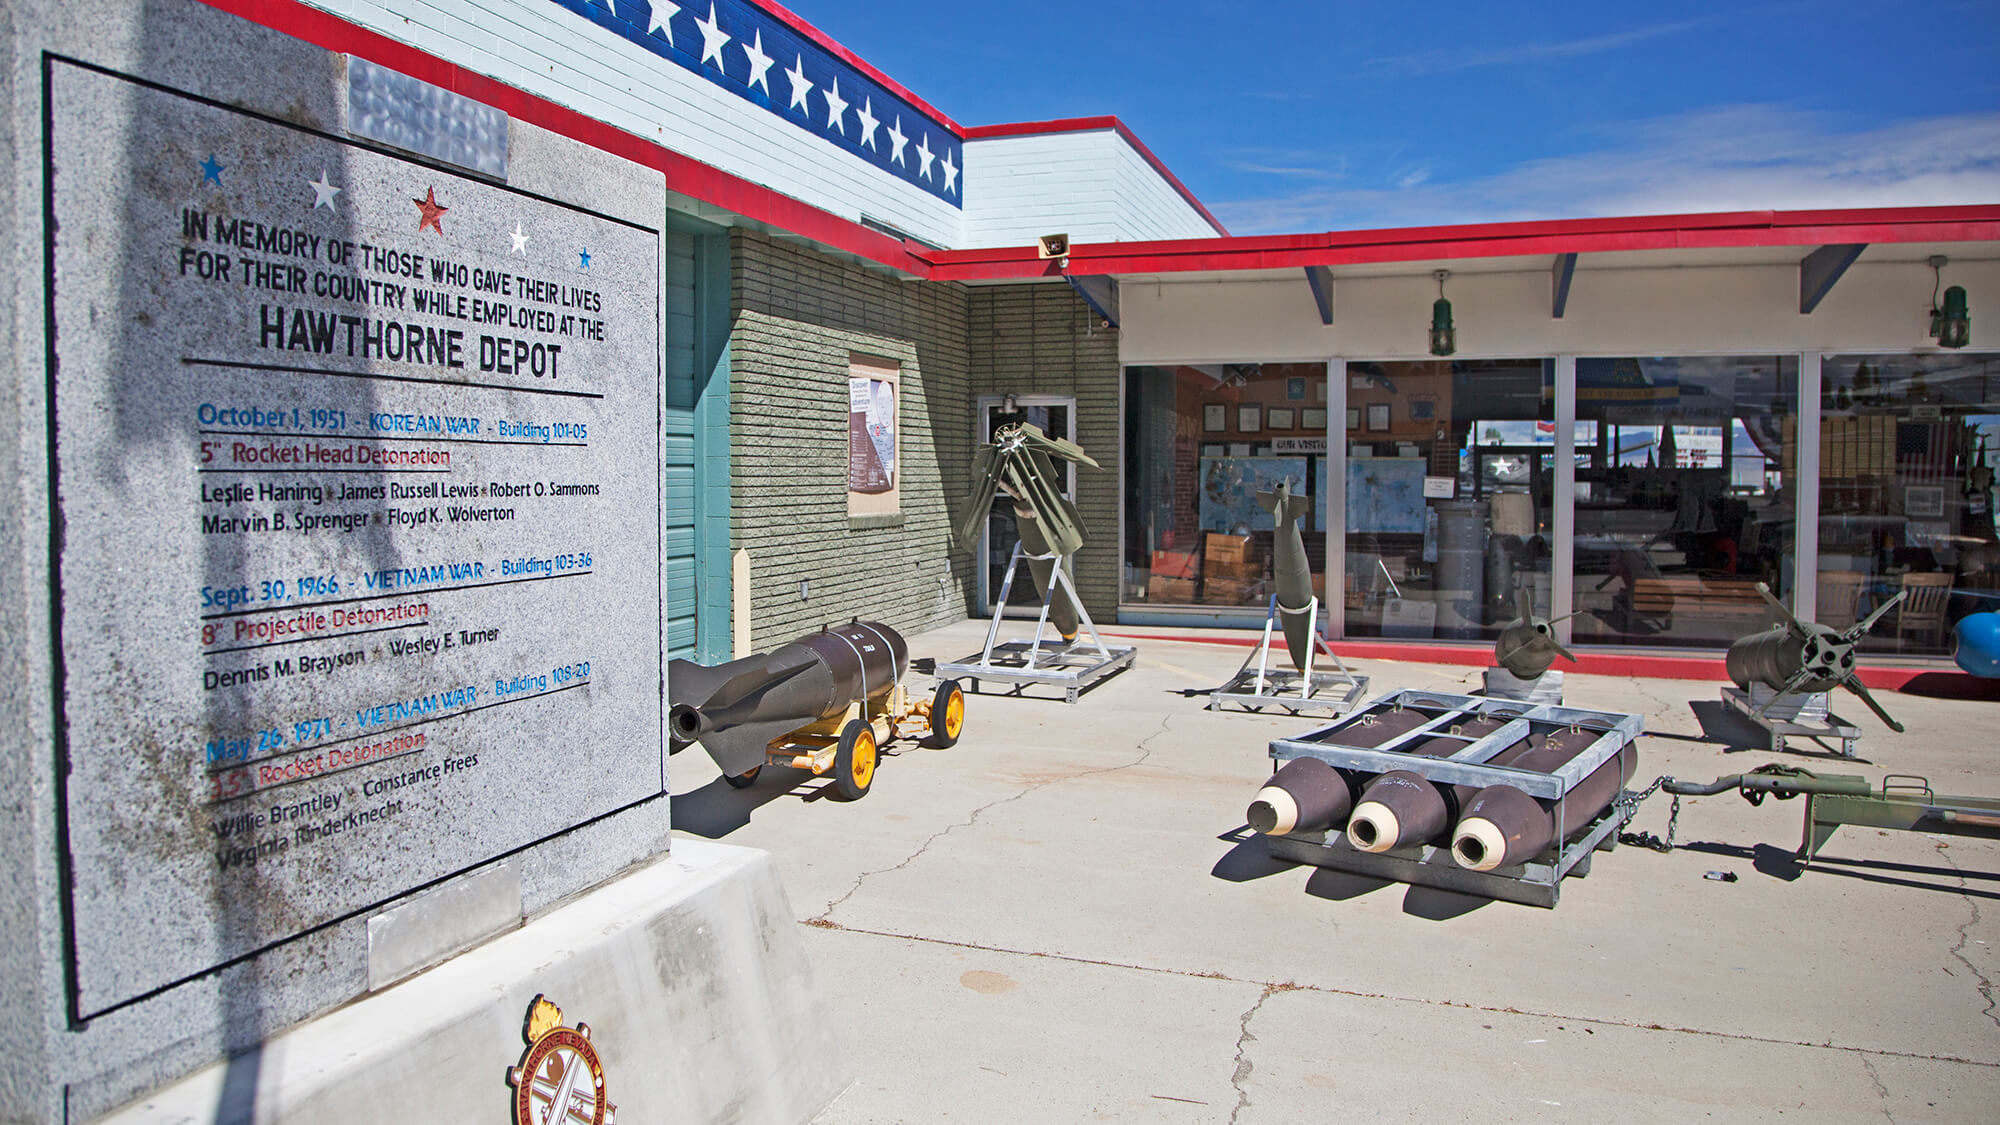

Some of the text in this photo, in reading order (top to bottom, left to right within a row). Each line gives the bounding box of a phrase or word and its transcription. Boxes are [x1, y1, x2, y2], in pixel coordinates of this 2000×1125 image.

[181, 208, 601, 313] IN MEMORY OF THOSE WHO GAVE THEIR LIVES
[180, 248, 605, 341] FOR THEIR COUNTRY WHILE EMPLOYED AT THE
[260, 304, 561, 379] HAWTHORNE DEPOT
[198, 403, 286, 428] October
[292, 408, 304, 430] 1,
[309, 409, 346, 430] 1951
[369, 412, 441, 433] KOREAN
[445, 416, 480, 435] WAR
[499, 420, 550, 442] Building
[552, 422, 588, 439] 101-05
[200, 441, 451, 465] 5" Rocket Head Detonation
[201, 482, 600, 505] Leslie Haning James Russell Lewis Robert O. Sammons
[202, 506, 515, 535] Marvin B. Sprenger Floyd K. Wolverton
[201, 584, 255, 611] Sept.
[260, 580, 292, 602] 30,
[297, 575, 339, 597] 1966
[364, 564, 445, 589] VIETNAM
[448, 561, 484, 582] WAR
[501, 556, 552, 576] Building
[555, 552, 593, 569] 103-36
[202, 602, 429, 645] 8" Projectile Detonation
[203, 628, 500, 690] Dennis M. Brayson Wesley E. Turner
[206, 737, 251, 763] May
[257, 728, 288, 751] 26,
[294, 717, 331, 743] 1971
[356, 695, 437, 728] VIETNAM
[440, 685, 476, 709] WAR
[495, 674, 547, 697] Building
[552, 661, 591, 684] 108-20
[259, 754, 324, 786] Rocket
[328, 733, 425, 769] Detonation
[213, 753, 479, 839] Willie Brantley Constance Frees
[215, 799, 404, 872] Virginia Rinderknecht
